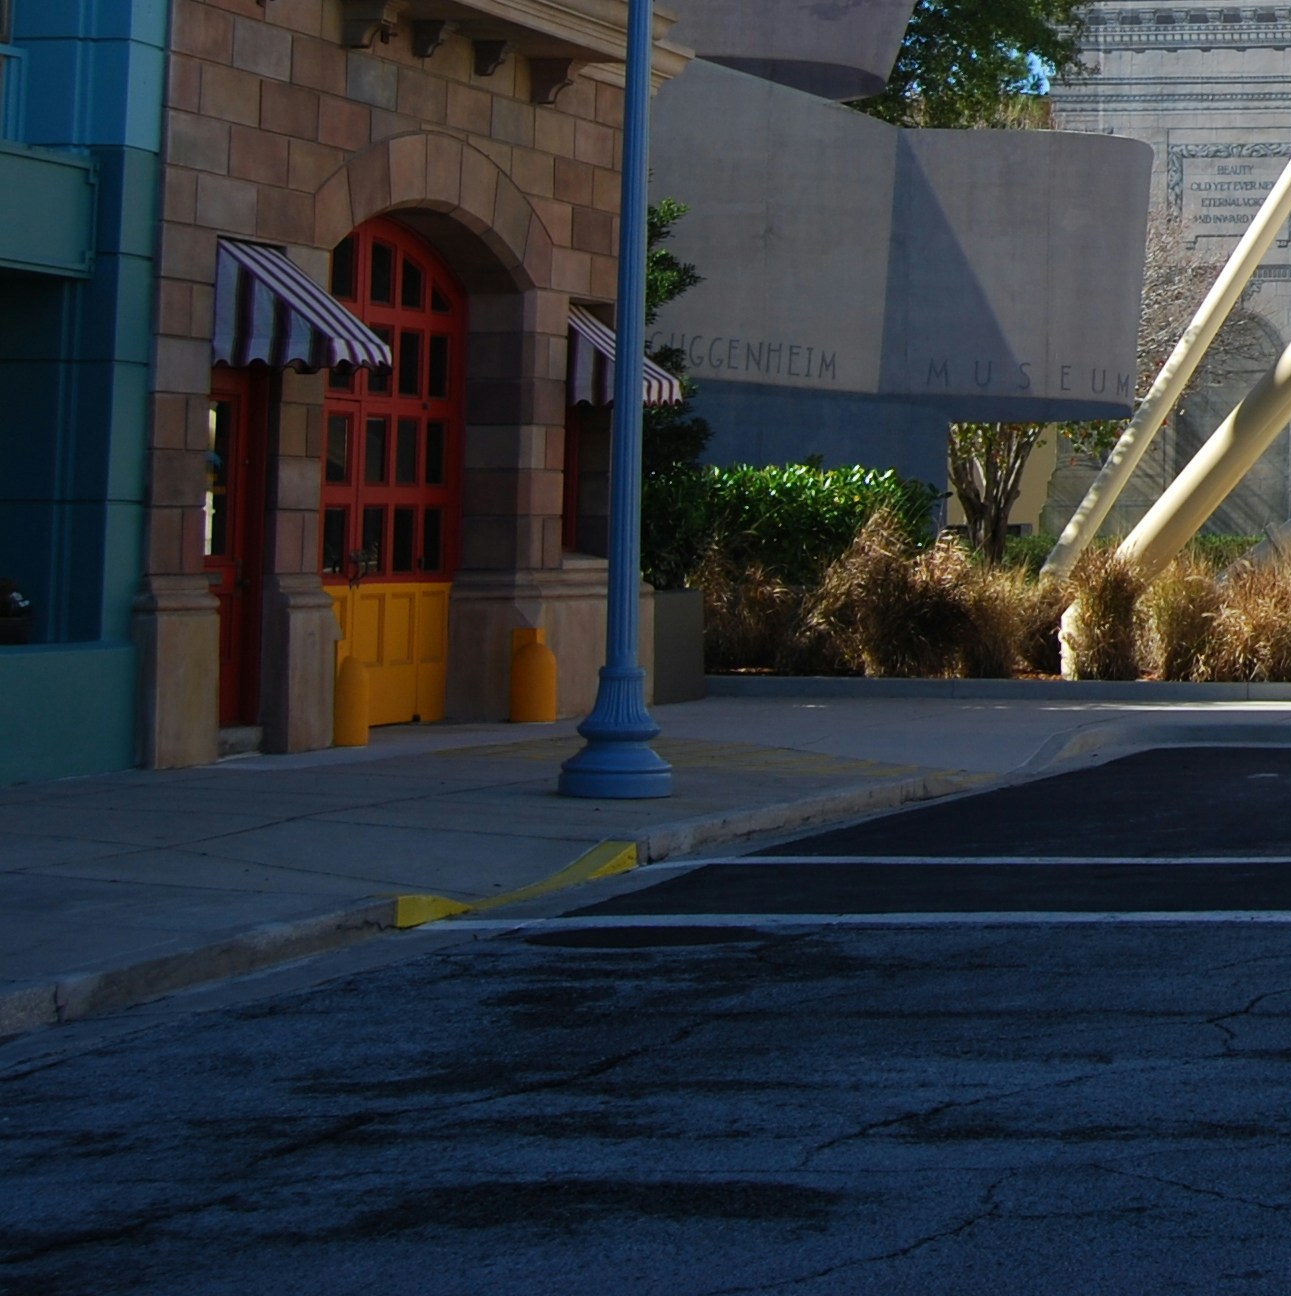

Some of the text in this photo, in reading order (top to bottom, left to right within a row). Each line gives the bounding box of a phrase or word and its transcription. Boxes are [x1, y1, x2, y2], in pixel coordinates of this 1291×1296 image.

[1217, 165, 1255, 175] BEAUTY
[1190, 182, 1212, 191] OLD
[1212, 181, 1233, 191] YET
[1233, 180, 1257, 191] EVER
[1201, 196, 1242, 207] ETERNAL
[1213, 214, 1250, 223] INWARD
[926, 358, 1131, 398] MUSEUM
